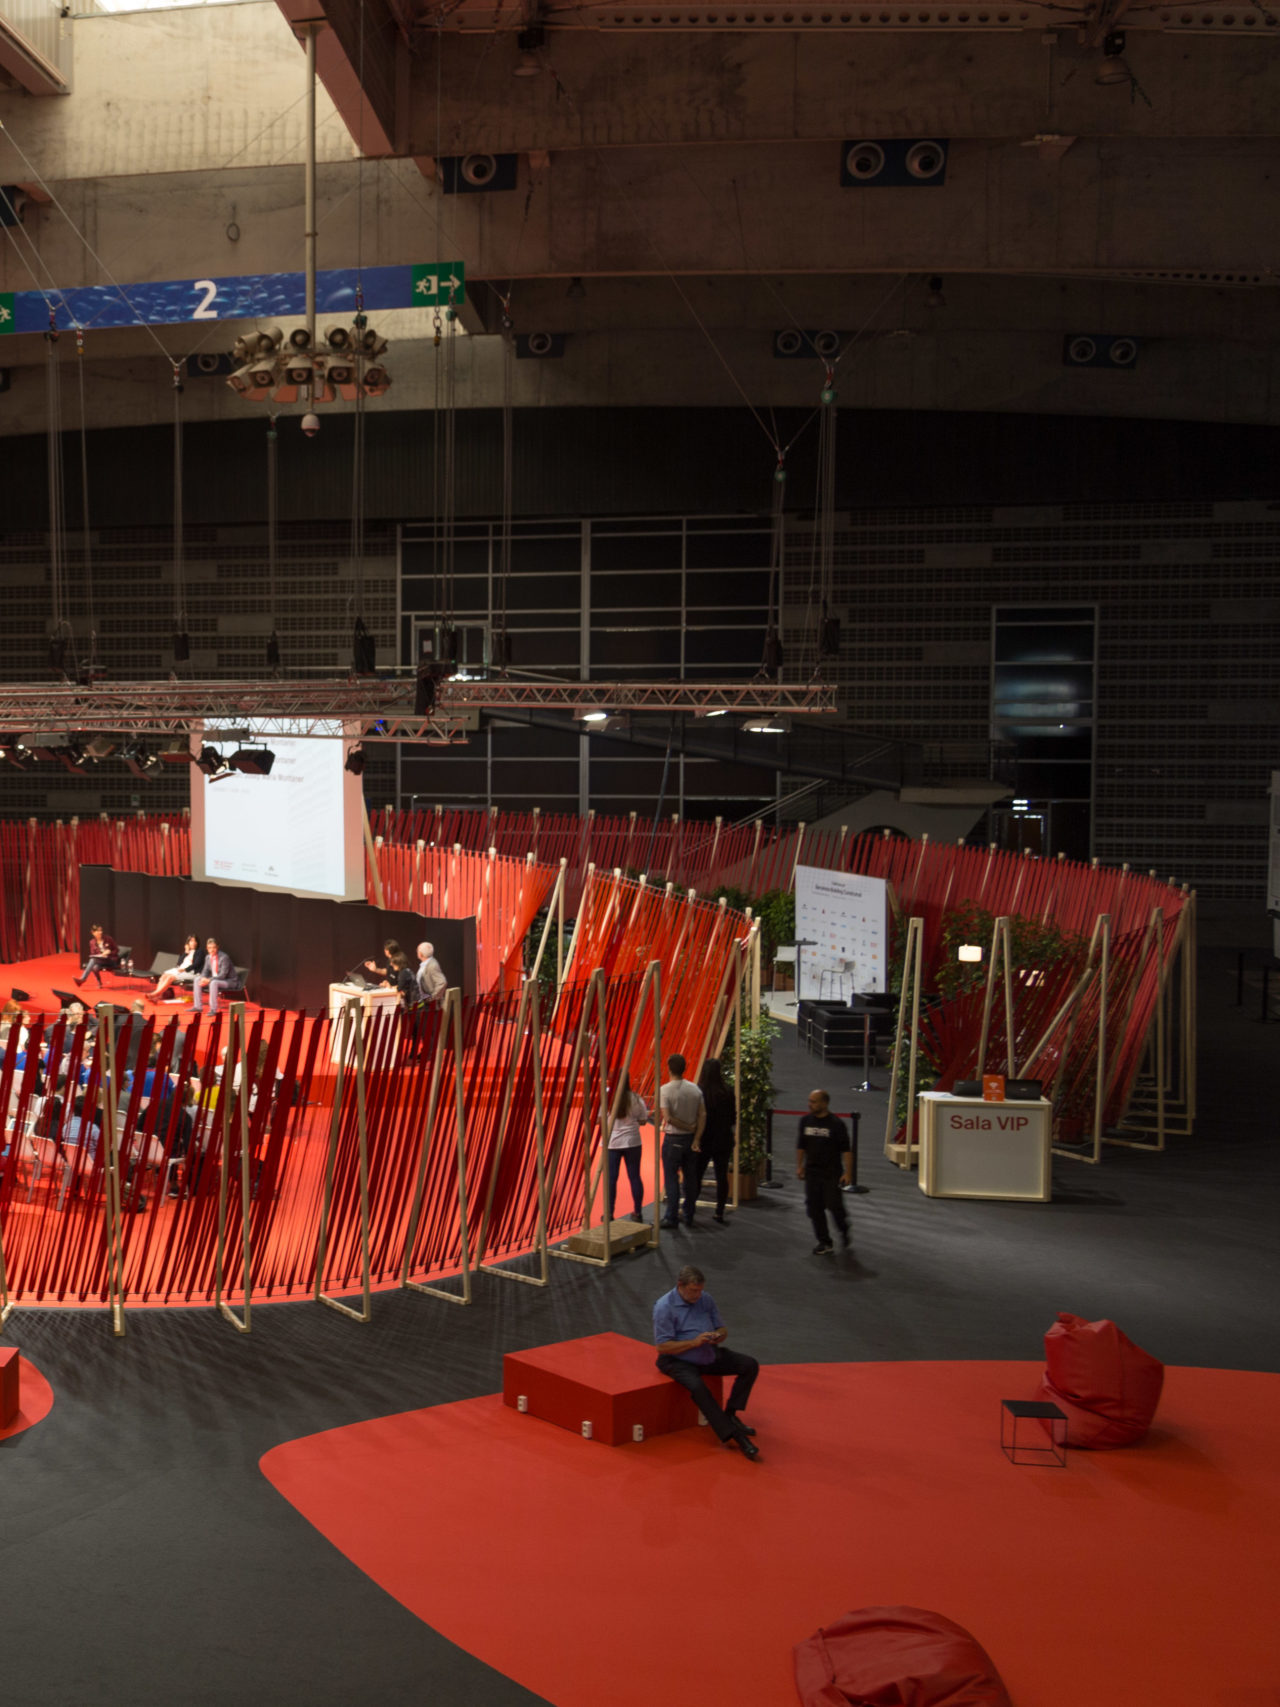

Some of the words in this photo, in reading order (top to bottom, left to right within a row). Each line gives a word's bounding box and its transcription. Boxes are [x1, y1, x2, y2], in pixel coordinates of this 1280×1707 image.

[192, 280, 219, 320] 2
[950, 1114, 992, 1130] Sala
[996, 1116, 1029, 1131] VIP
